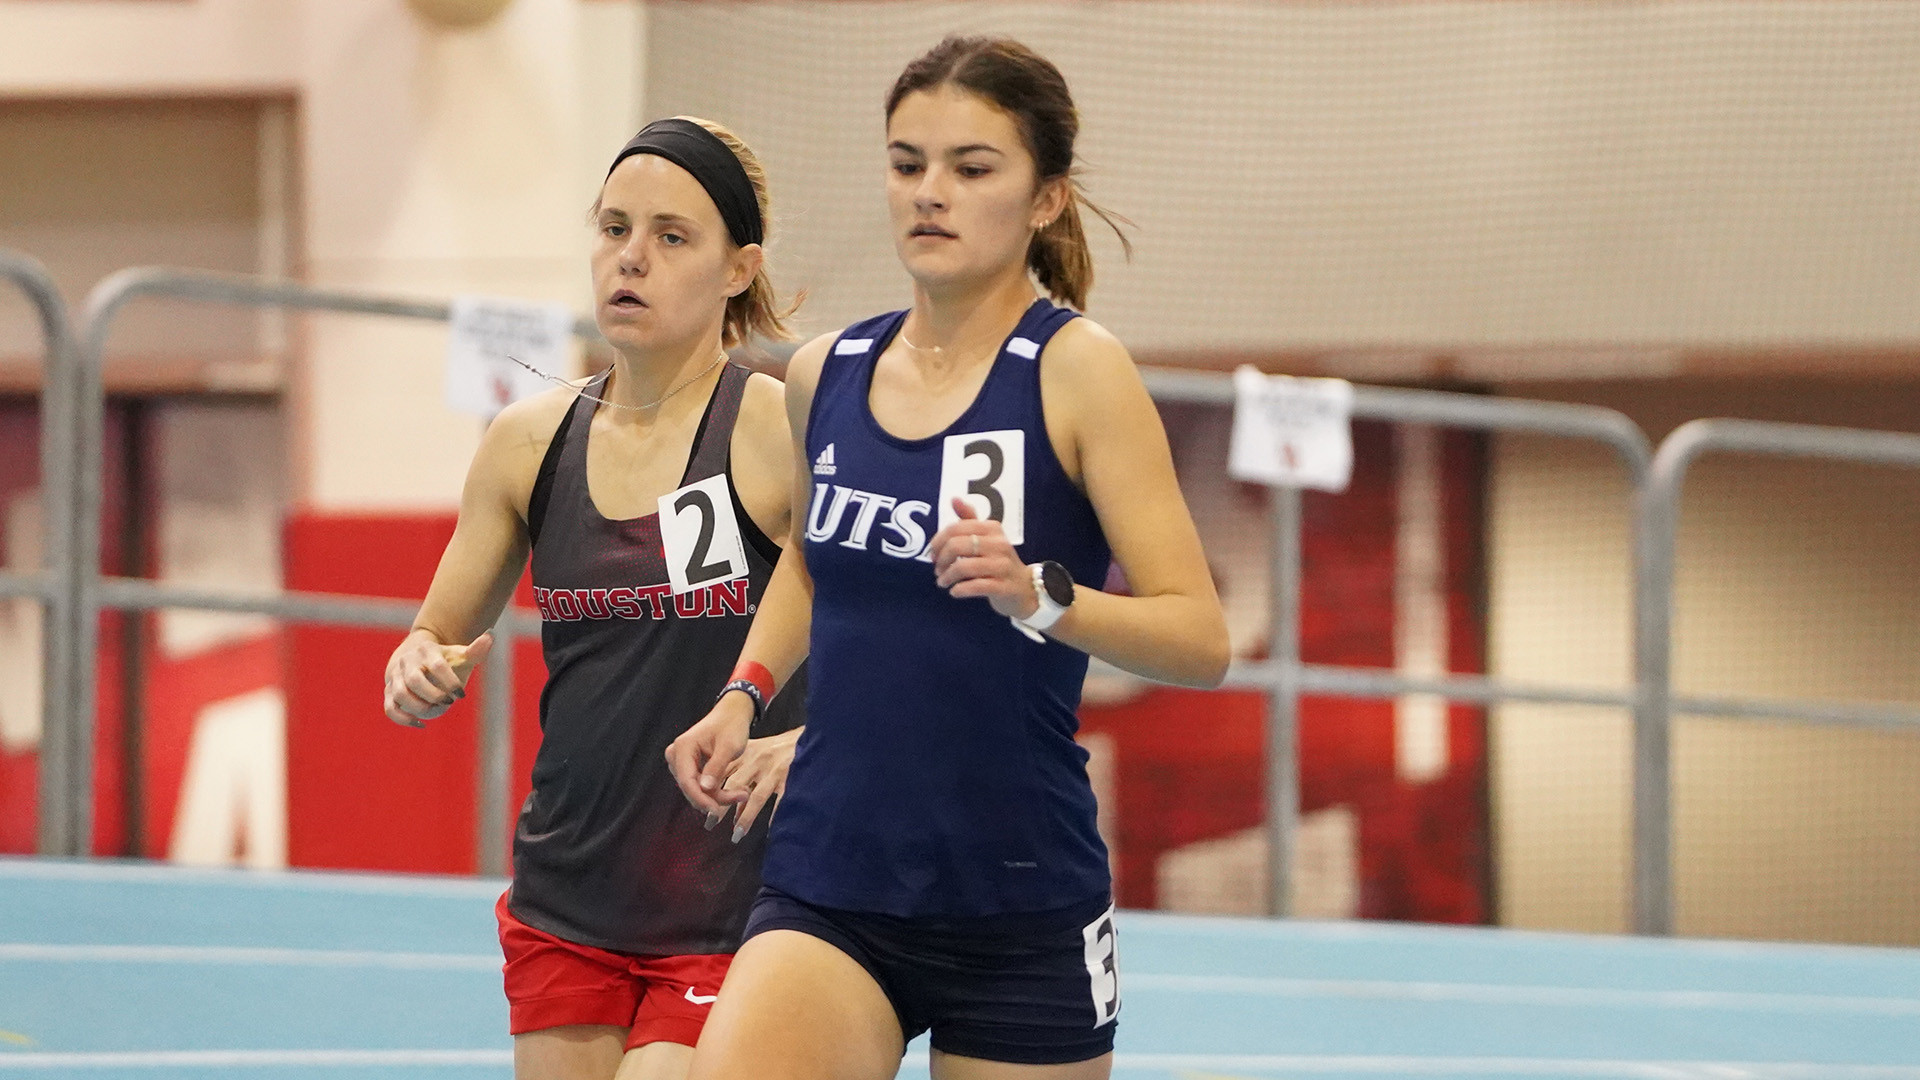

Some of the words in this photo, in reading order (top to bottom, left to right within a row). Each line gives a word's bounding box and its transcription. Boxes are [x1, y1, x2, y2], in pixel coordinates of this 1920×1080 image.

[964, 440, 1004, 524] 3
[674, 490, 733, 585] 2
[533, 578, 750, 621] HOUSTON
